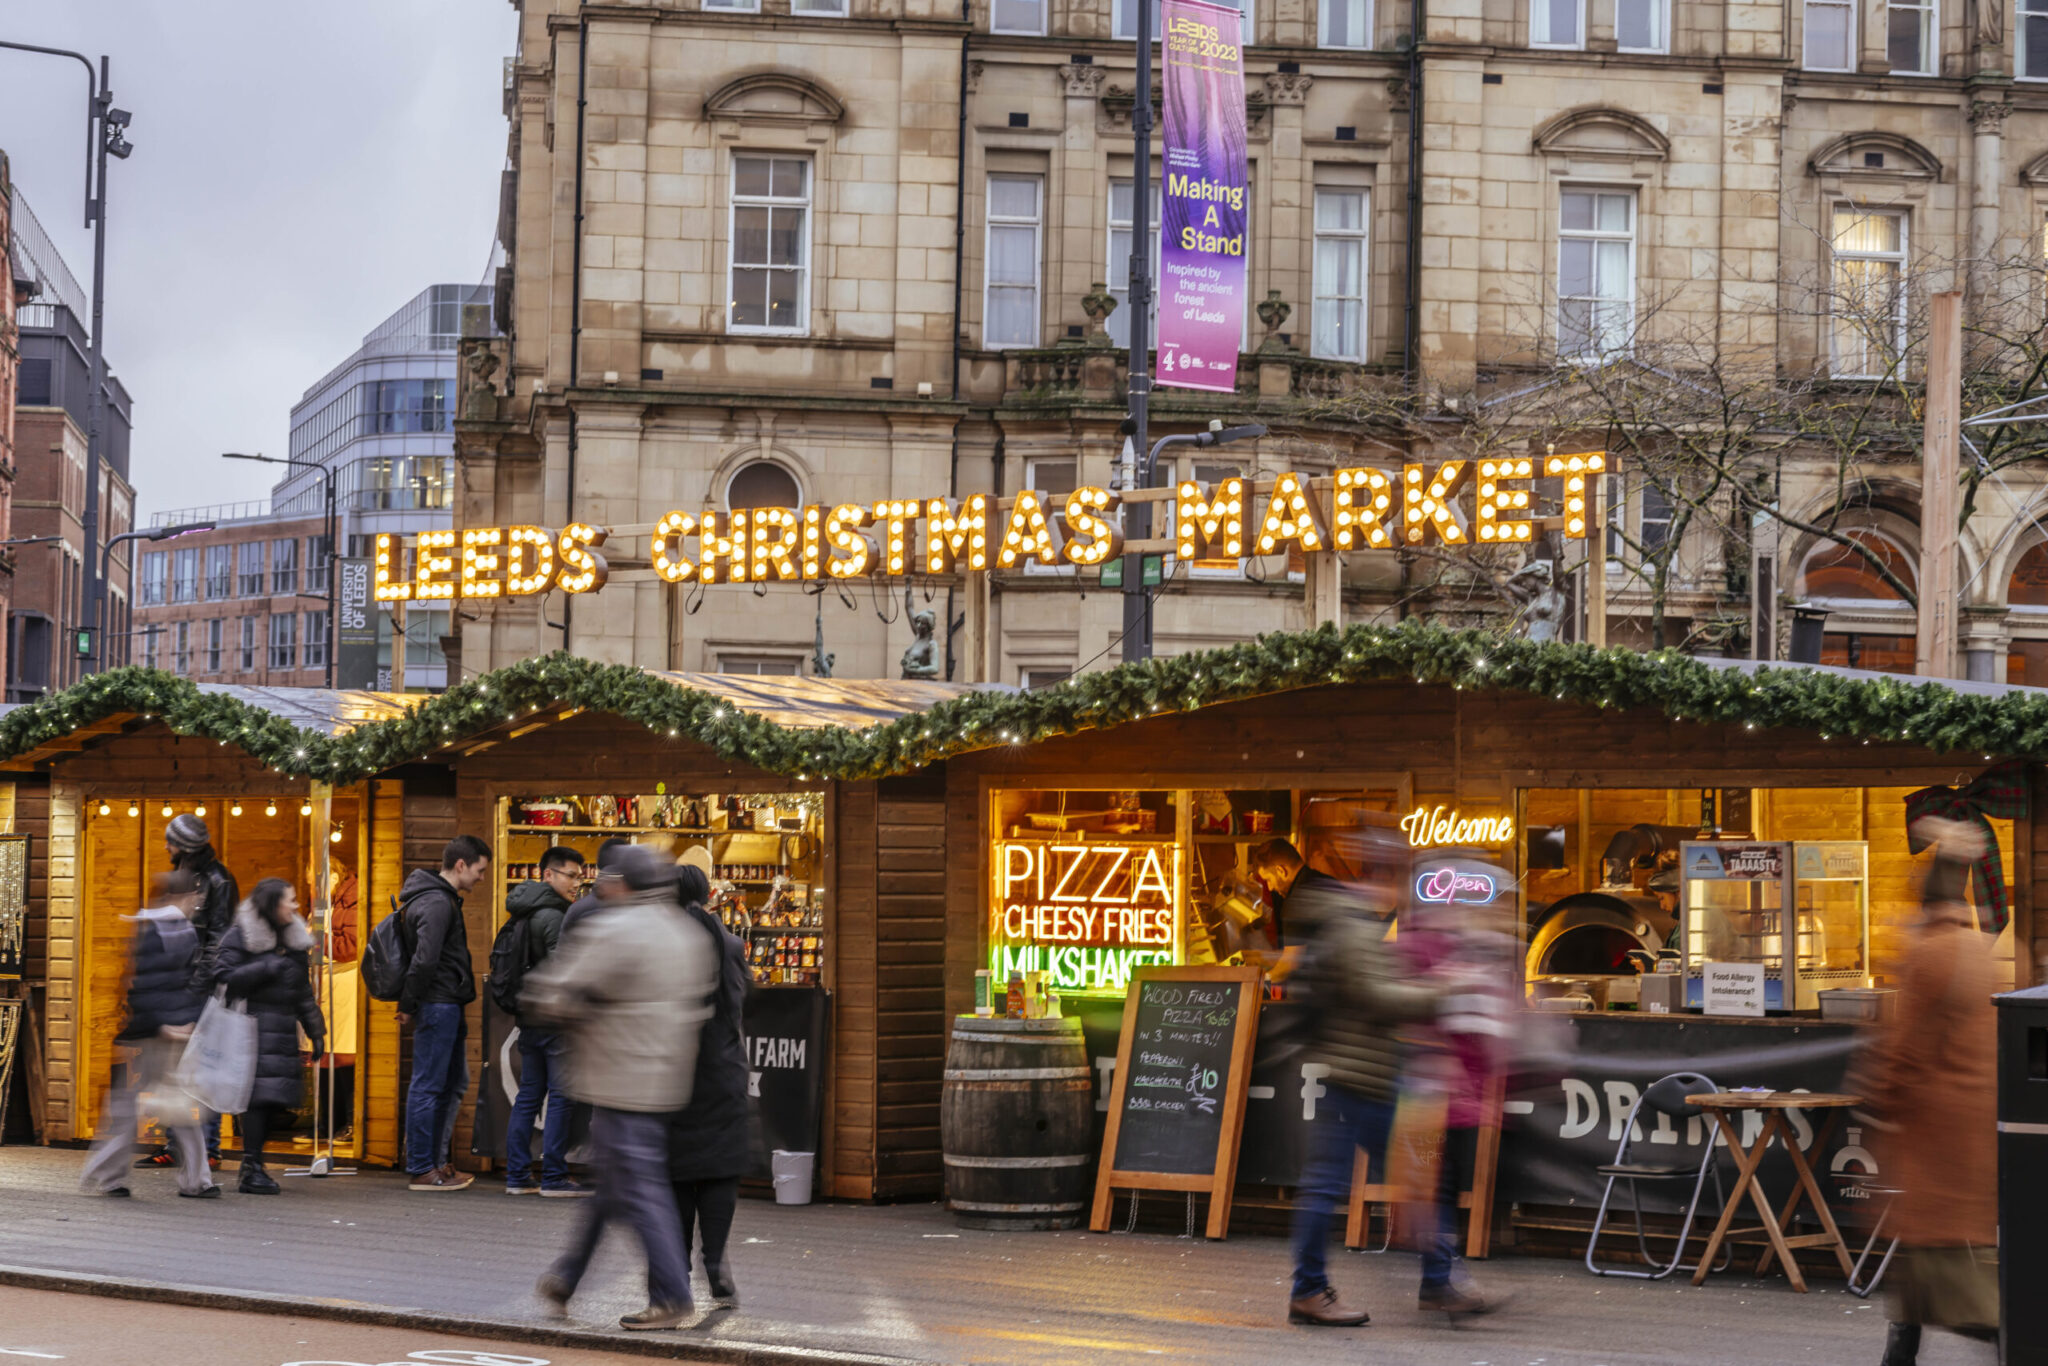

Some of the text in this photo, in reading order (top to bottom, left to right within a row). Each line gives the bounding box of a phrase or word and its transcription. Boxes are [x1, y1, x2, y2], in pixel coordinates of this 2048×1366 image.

[1168, 16, 1219, 42] LEEDS
[1200, 40, 1238, 62] 2023
[1168, 173, 1244, 211] Making
[1203, 205, 1220, 228] A
[1181, 226, 1242, 256] Stand
[1167, 262, 1221, 281] Inspired by
[1174, 291, 1205, 307] forest
[1180, 279, 1233, 295] the ancient
[1183, 308, 1225, 324] of Leeds
[374, 450, 1608, 601] LEEDS CHRISTMAS MARKET
[341, 563, 354, 629] UNIVERSITY
[353, 564, 368, 607] LEEDS
[352, 609, 366, 629] OF
[1400, 805, 1515, 846] Welcome
[1003, 844, 1172, 905] PIZZA
[1426, 868, 1491, 905] Open
[1003, 904, 1172, 944] CHEESY FRIES
[1712, 972, 1755, 983] Food Allergy
[1162, 1008, 1203, 1025] PIZZA
[1154, 1029, 1163, 1042] 3
[755, 1036, 807, 1069] FARM
[1140, 1051, 1184, 1065] PEPPERONI
